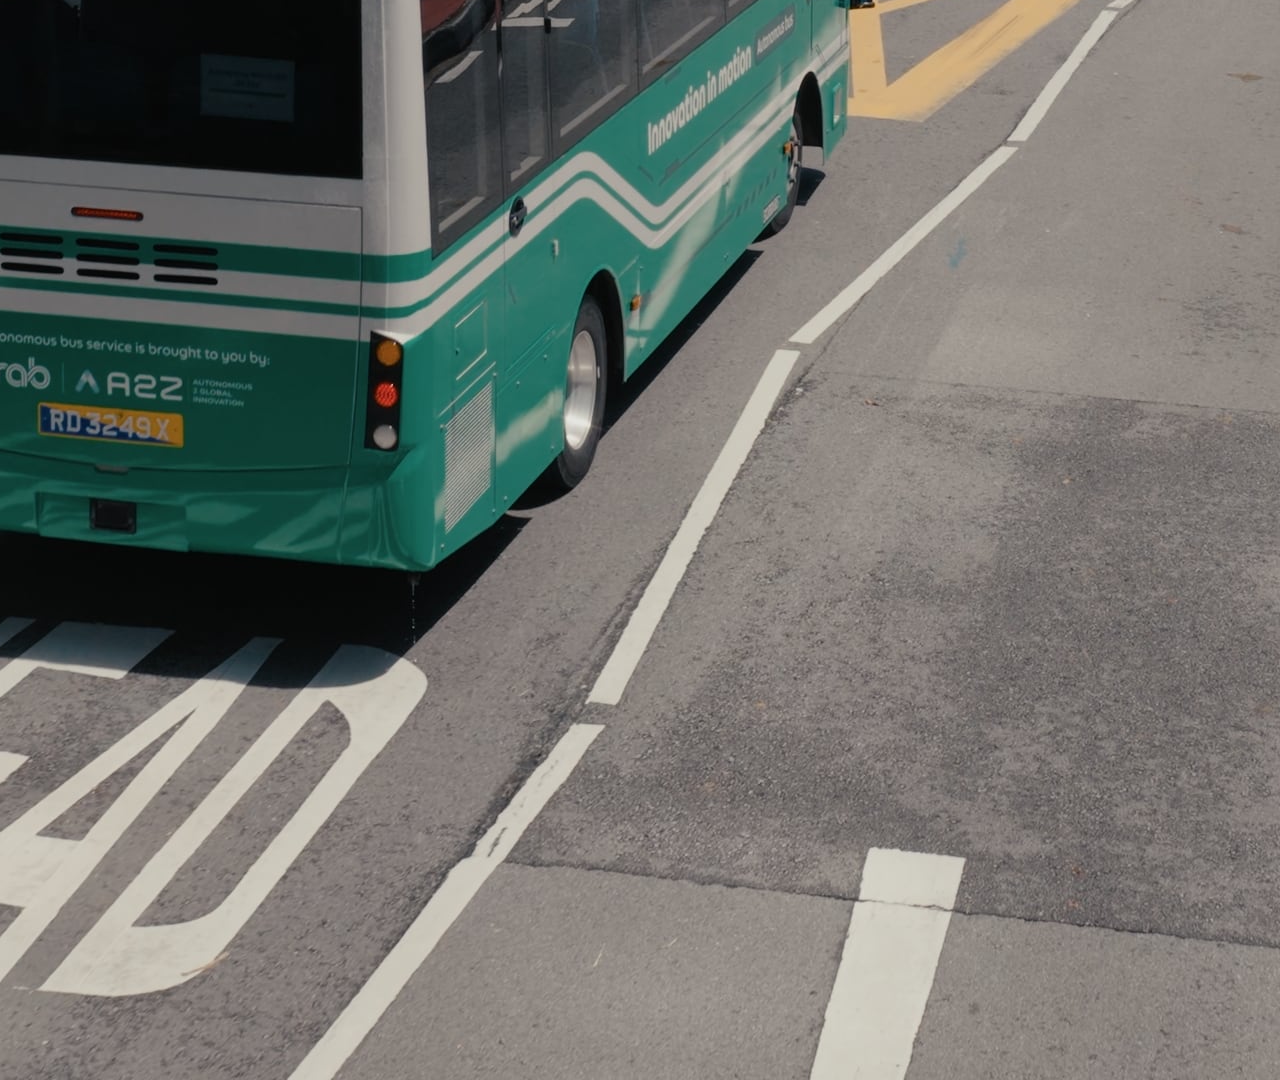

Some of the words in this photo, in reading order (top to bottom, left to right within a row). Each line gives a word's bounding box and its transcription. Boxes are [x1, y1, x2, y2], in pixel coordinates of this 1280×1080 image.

[647, 85, 706, 155] Innovation
[707, 71, 717, 104] in
[718, 45, 752, 95] motion
[60, 334, 83, 350] bus
[86, 338, 132, 353] service
[135, 342, 145, 354] is
[148, 342, 202, 361] brought
[204, 347, 219, 361] to
[221, 351, 246, 365] you
[249, 351, 271, 368] by:
[107, 371, 183, 401] A2Z
[192, 379, 253, 391] AUTONOMOUS
[199, 388, 232, 398] GLOBAL
[193, 396, 245, 407] INNOVATION
[49, 407, 82, 433] RD
[86, 410, 151, 439] 3249
[157, 418, 171, 441] X
